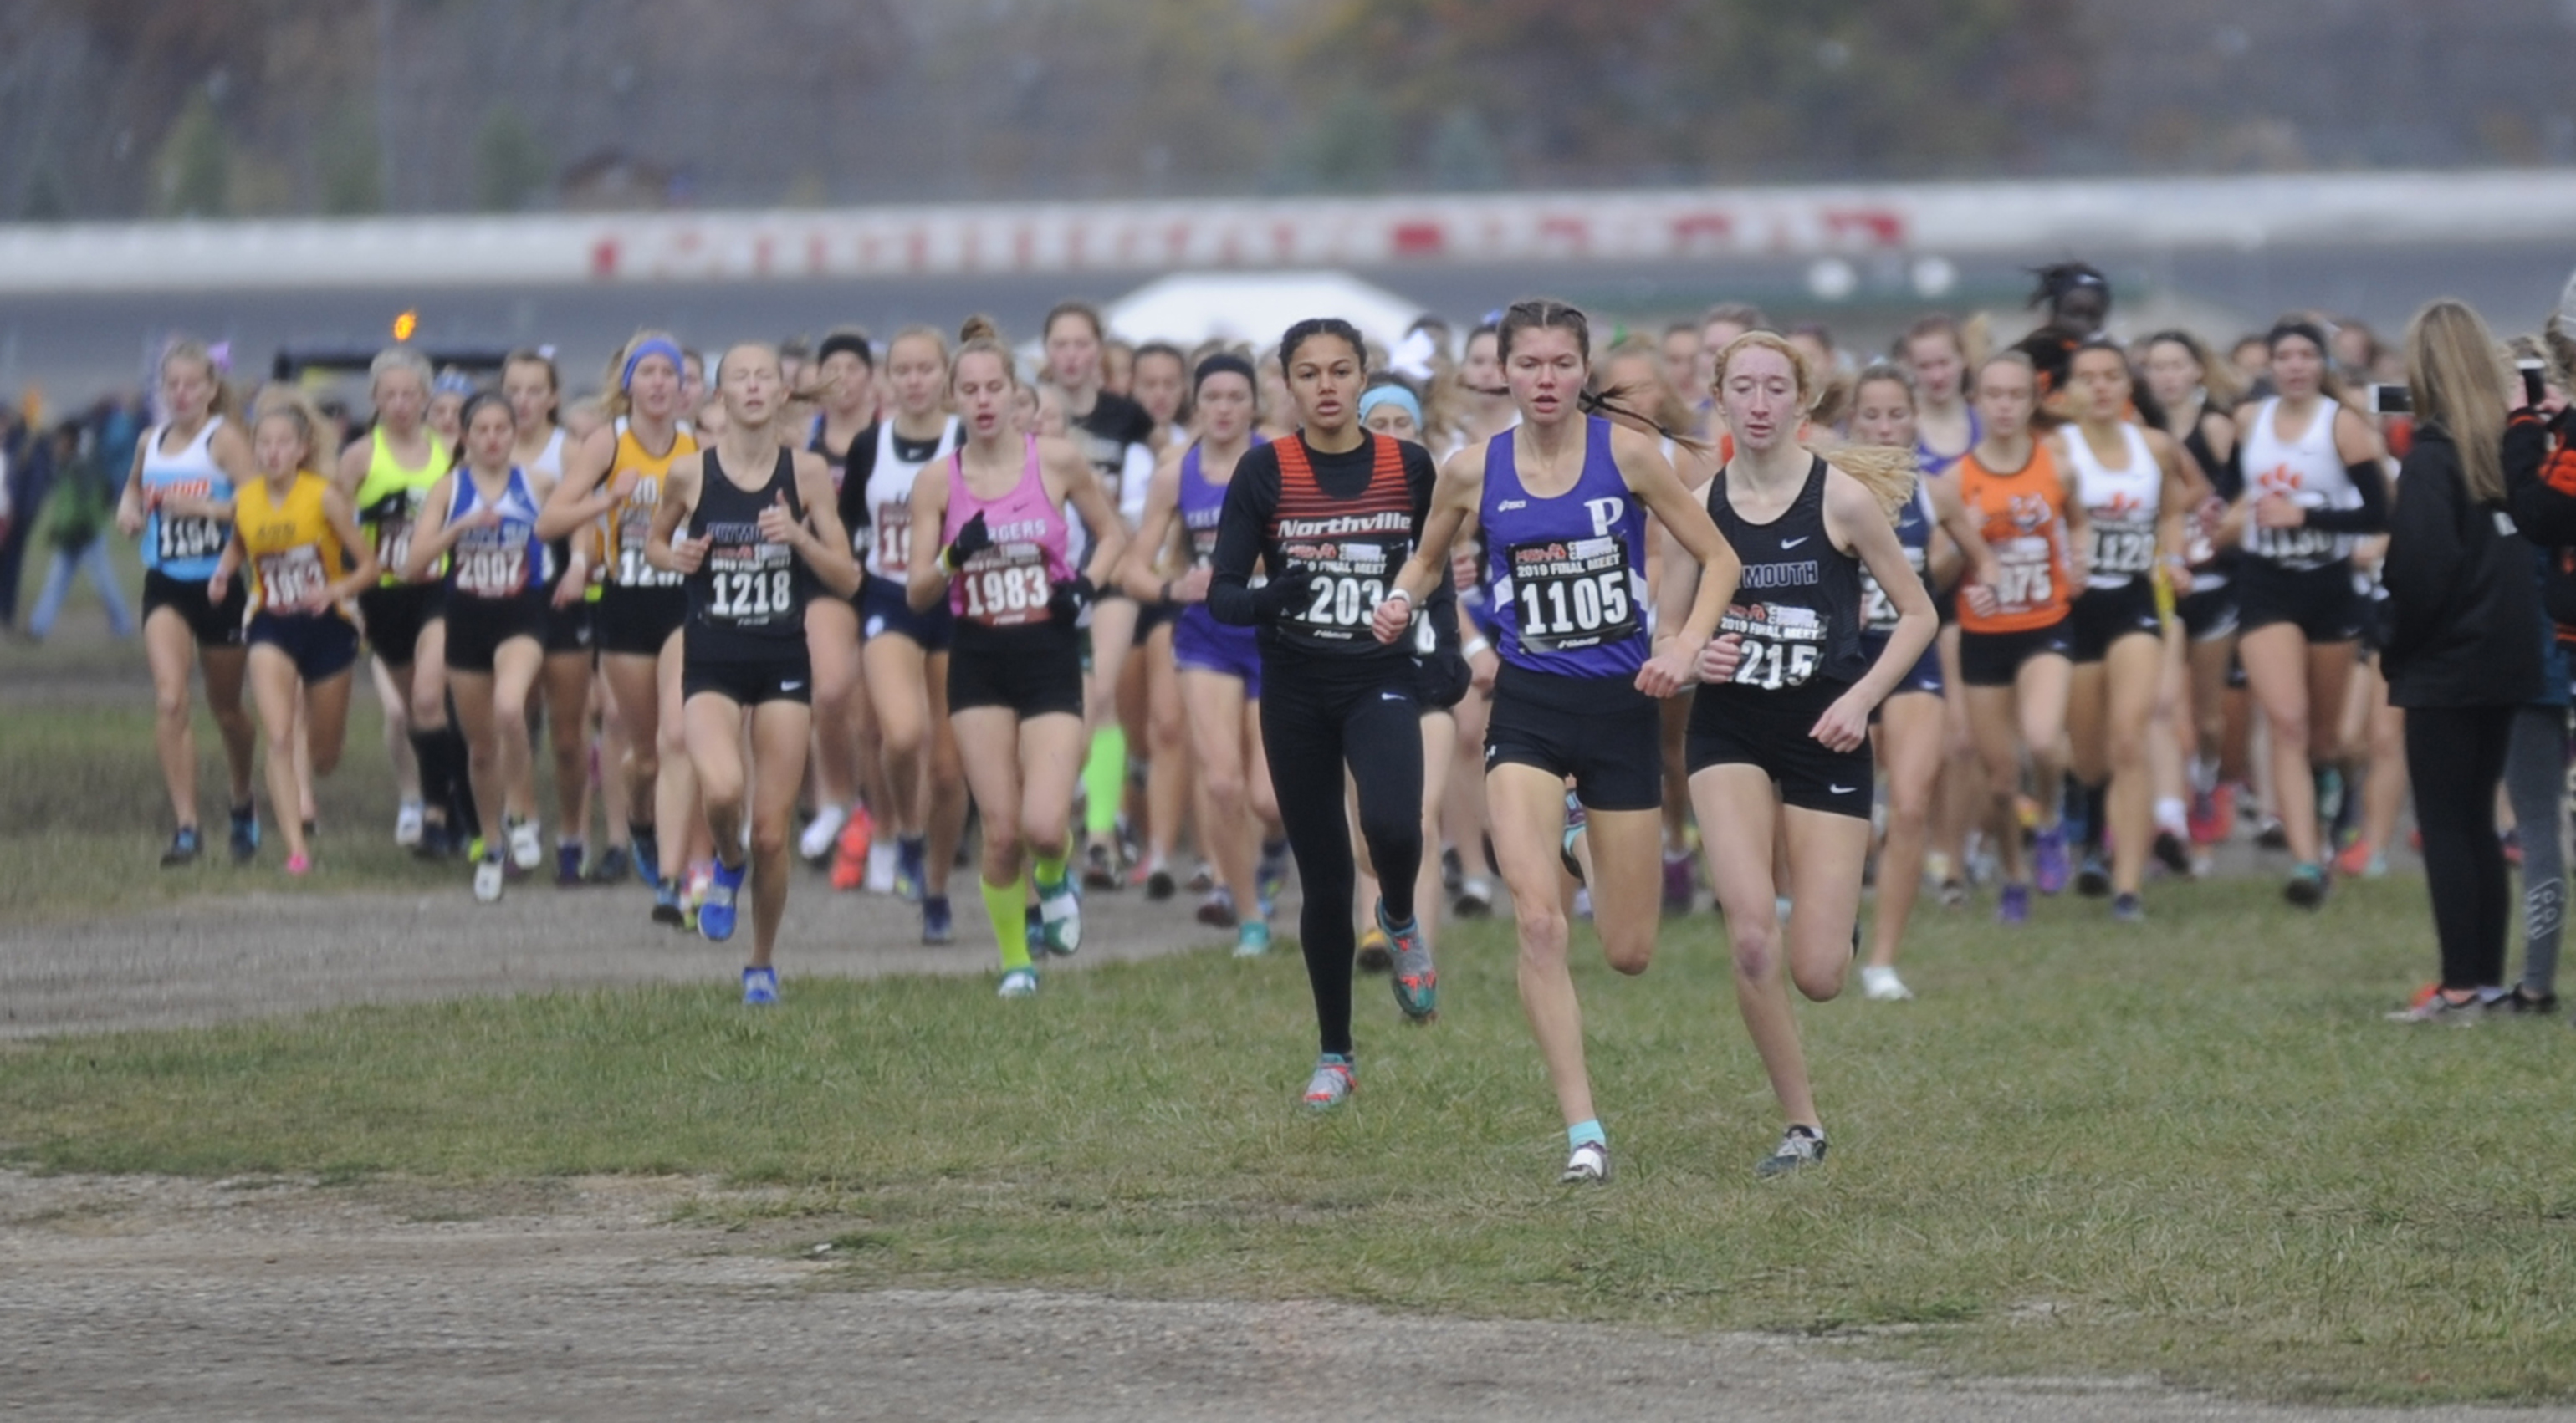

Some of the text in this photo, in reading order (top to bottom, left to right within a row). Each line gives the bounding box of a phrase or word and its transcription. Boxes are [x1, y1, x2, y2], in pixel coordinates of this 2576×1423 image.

[1278, 513, 1412, 538] Northville
[1583, 497, 1624, 537] P
[456, 548, 523, 590] 2007
[1516, 553, 1620, 579] 2019 FINAL MEET
[1742, 560, 1818, 589] MOUTH
[712, 569, 791, 616] 1218
[965, 564, 1049, 616] 1983
[1295, 576, 1385, 625] 203
[1521, 570, 1628, 635] 1105
[1728, 639, 1818, 691] 215
